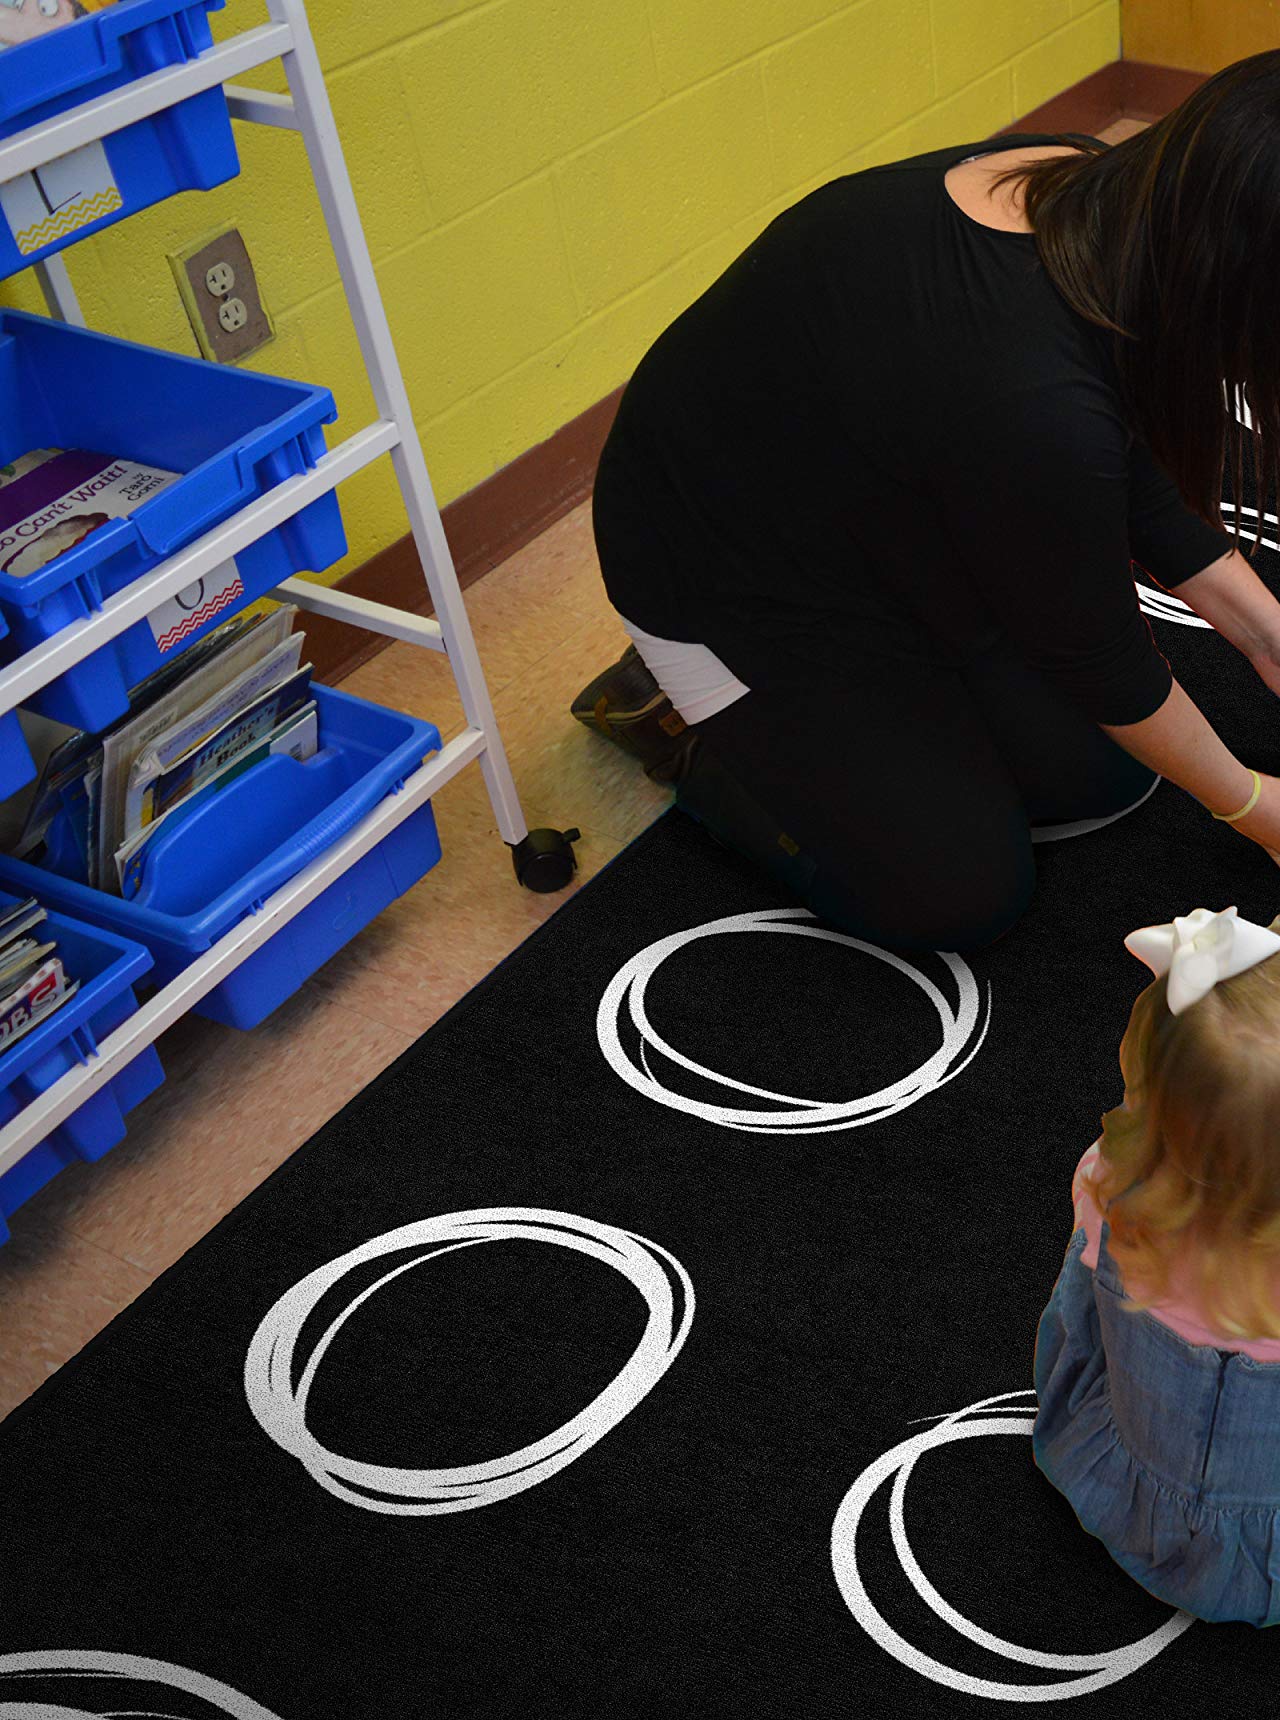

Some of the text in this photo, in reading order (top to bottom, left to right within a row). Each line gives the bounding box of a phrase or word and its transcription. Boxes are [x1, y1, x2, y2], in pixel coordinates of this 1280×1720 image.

[119, 474, 152, 495] Taro
[127, 477, 165, 502] Gomi
[15, 501, 73, 537] Can't
[69, 464, 129, 503] Wait!
